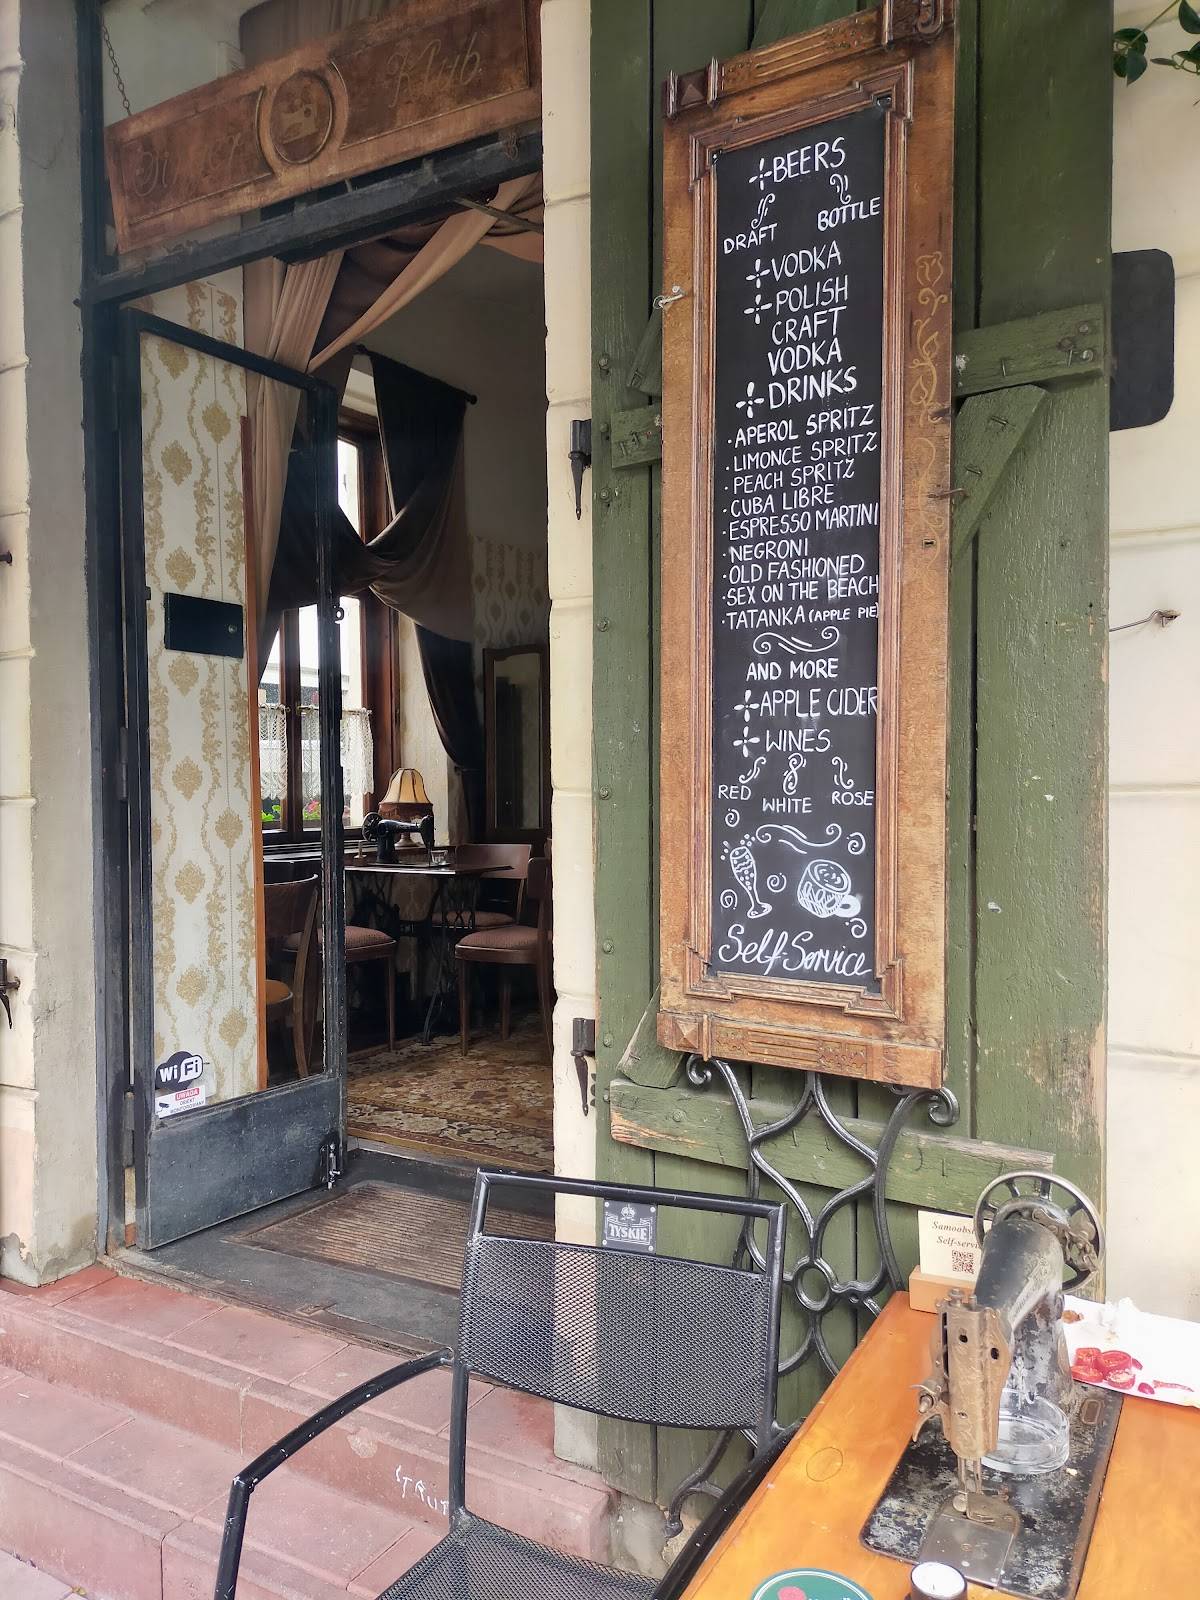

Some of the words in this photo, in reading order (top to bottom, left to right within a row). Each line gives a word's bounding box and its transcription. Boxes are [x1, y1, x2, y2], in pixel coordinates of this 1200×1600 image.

[773, 136, 846, 183] BEERS
[723, 223, 778, 255] DRAFT
[817, 197, 881, 232] BOTTLE
[771, 240, 842, 282] VODKA
[776, 275, 848, 315] POLISH
[771, 306, 847, 346] CRAFT
[768, 338, 843, 377] VODKA
[768, 366, 858, 410] DRINKS
[734, 419, 799, 449] APEROL
[805, 404, 875, 436] SPRITZ
[733, 446, 803, 473] LIMONCE
[810, 432, 878, 462] SPRITZ
[733, 471, 784, 495] PEACH
[790, 459, 855, 487] SPRITZ
[730, 497, 775, 518] CUBA
[782, 484, 835, 511] LIBRE
[729, 512, 811, 541] ESPRESSO
[815, 503, 879, 531] MARTINI
[729, 538, 809, 564] NEGRONI
[729, 563, 763, 585] OLD
[767, 554, 865, 580] FASHIONED
[726, 585, 757, 607] SEX
[761, 582, 784, 604] ON
[787, 580, 819, 601] THE
[827, 575, 879, 599] BEACH
[726, 605, 806, 631] TATANKA
[808, 608, 851, 623] (APPLE
[745, 662, 783, 682] AND
[789, 658, 839, 680] MORE
[760, 688, 821, 718] APPLE
[826, 687, 877, 717] CIDER
[765, 728, 831, 753] WINES
[718, 785, 752, 801] RED
[762, 797, 813, 814] WHITE
[831, 791, 875, 806] ROSE
[608, 1223, 649, 1242] TYSKIE
